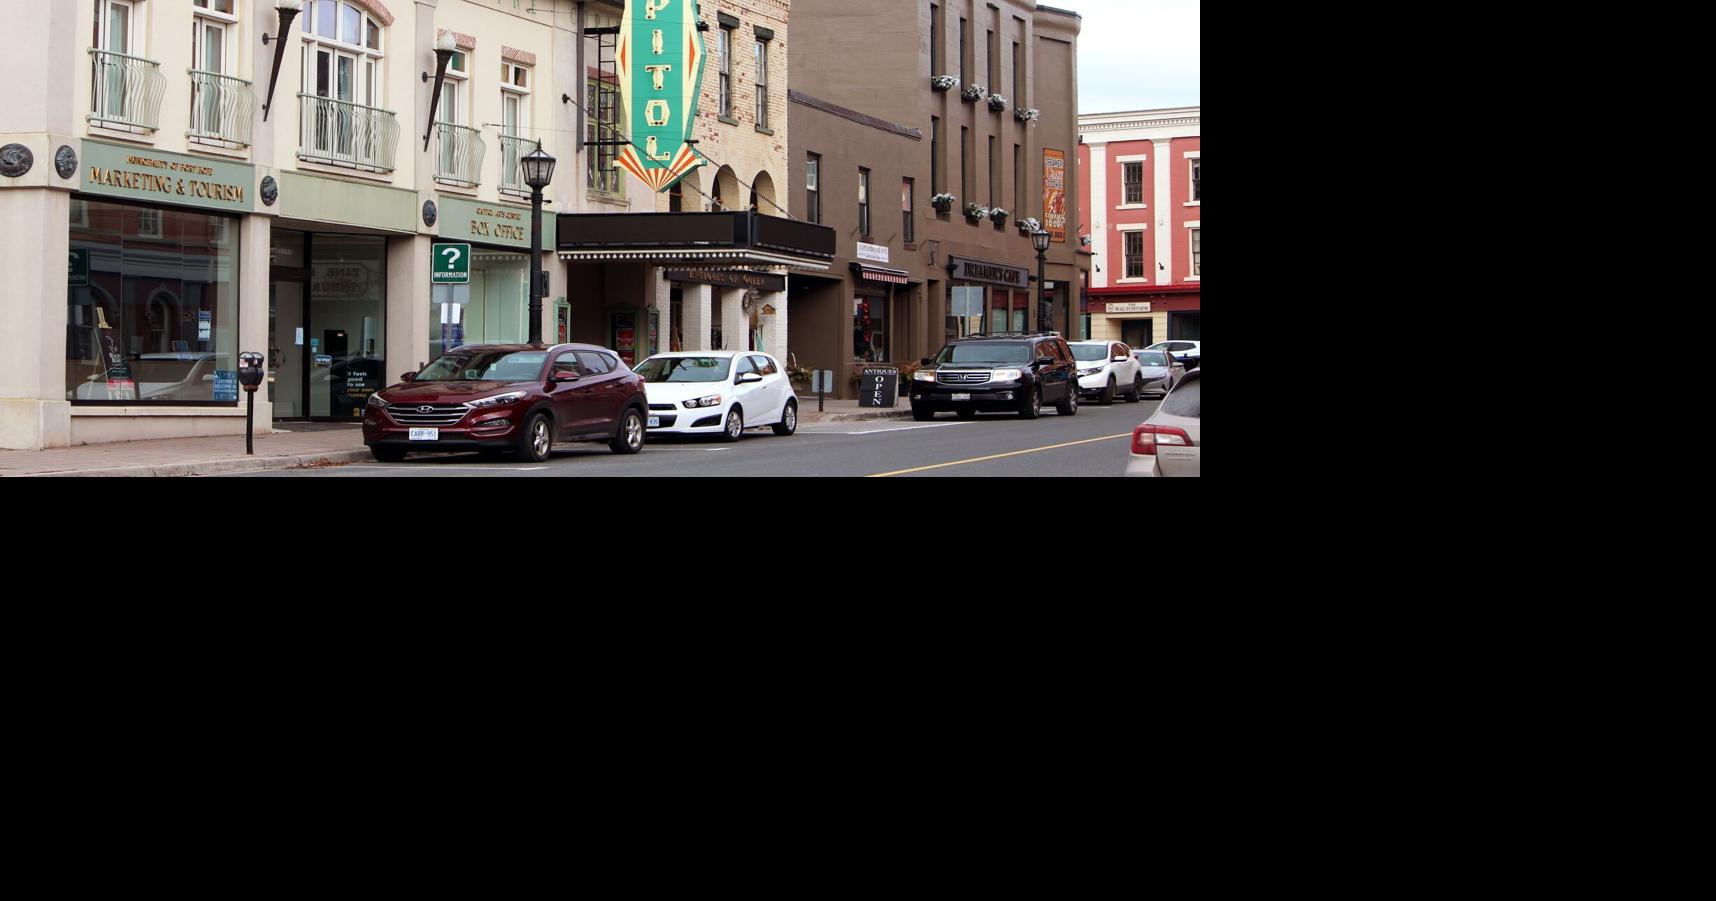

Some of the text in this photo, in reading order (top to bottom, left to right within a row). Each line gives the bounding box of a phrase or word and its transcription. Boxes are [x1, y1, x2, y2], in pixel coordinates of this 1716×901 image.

[170, 162, 179, 171] OF
[180, 163, 196, 174] PORT
[89, 166, 244, 202] MARKETING & TOURISM
[470, 219, 525, 241] BOX OFFICE
[433, 271, 467, 279] INFORMATION
[963, 262, 1004, 281] DREAMER'S
[872, 375, 884, 405] OPEN
